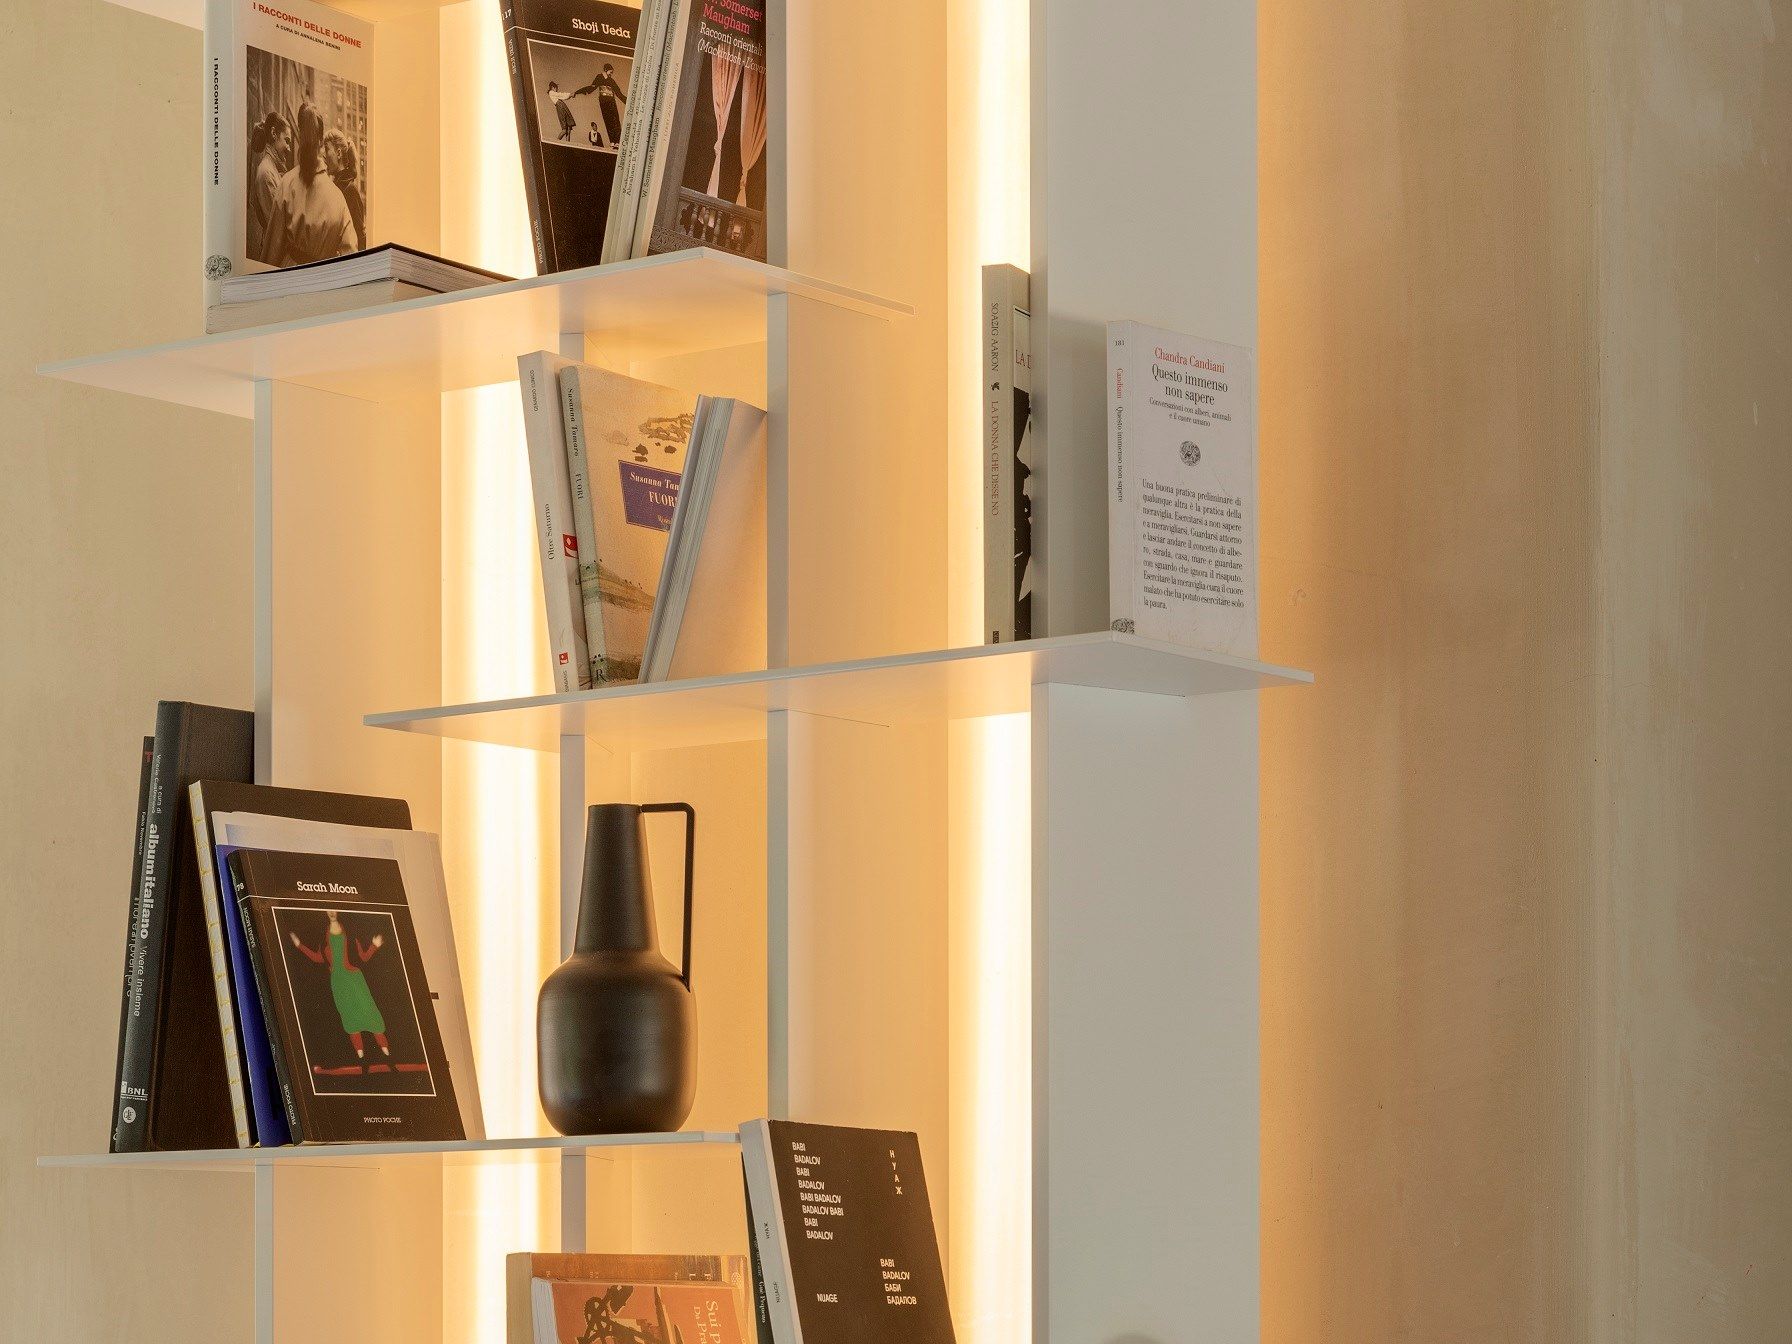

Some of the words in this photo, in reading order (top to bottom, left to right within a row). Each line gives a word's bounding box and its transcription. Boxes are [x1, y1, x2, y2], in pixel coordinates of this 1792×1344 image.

[703, 3, 750, 34] Maugham
[258, 4, 302, 26] RACCONTI
[304, 20, 330, 37] DELLE
[333, 30, 362, 48] DONNE
[572, 18, 599, 33] Shoji
[601, 24, 630, 38] Ueda
[700, 22, 732, 44] Racconti
[991, 338, 999, 371] AARON
[1155, 347, 1187, 365] Chandra
[1190, 355, 1225, 373] Candiani
[1152, 364, 1182, 381] Questo
[1185, 372, 1228, 392] immenso
[1165, 386, 1182, 398] non
[1185, 390, 1215, 405] sapere
[630, 472, 661, 487] Susanna
[1156, 482, 1174, 493] buona
[1176, 488, 1195, 498] pratica
[1175, 500, 1187, 509] altra
[1226, 509, 1241, 519] della
[1223, 524, 1241, 532] sapere
[1215, 560, 1242, 570] guardare
[140, 823, 160, 940] albumitaliano
[297, 881, 327, 892] Sarah
[329, 883, 358, 894] Moon
[137, 945, 147, 975] Vivere
[133, 978, 143, 1017] insieme
[128, 1087, 148, 1096] BNL
[792, 1142, 805, 1151] BABI
[794, 1155, 820, 1164] BADALOV
[796, 1167, 810, 1176] BABI
[798, 1180, 824, 1190] BADALOV
[800, 1193, 814, 1201] BABI
[814, 1193, 841, 1203] BADALOV
[802, 1205, 828, 1215] BADALOV
[830, 1207, 844, 1216] BABI
[804, 1218, 818, 1226] BABI
[806, 1230, 833, 1240] BADALOV
[880, 1259, 894, 1267] BABI
[883, 1271, 909, 1280] BADALOV
[817, 1293, 838, 1302] NUAGE
[706, 1300, 721, 1328] Sui
